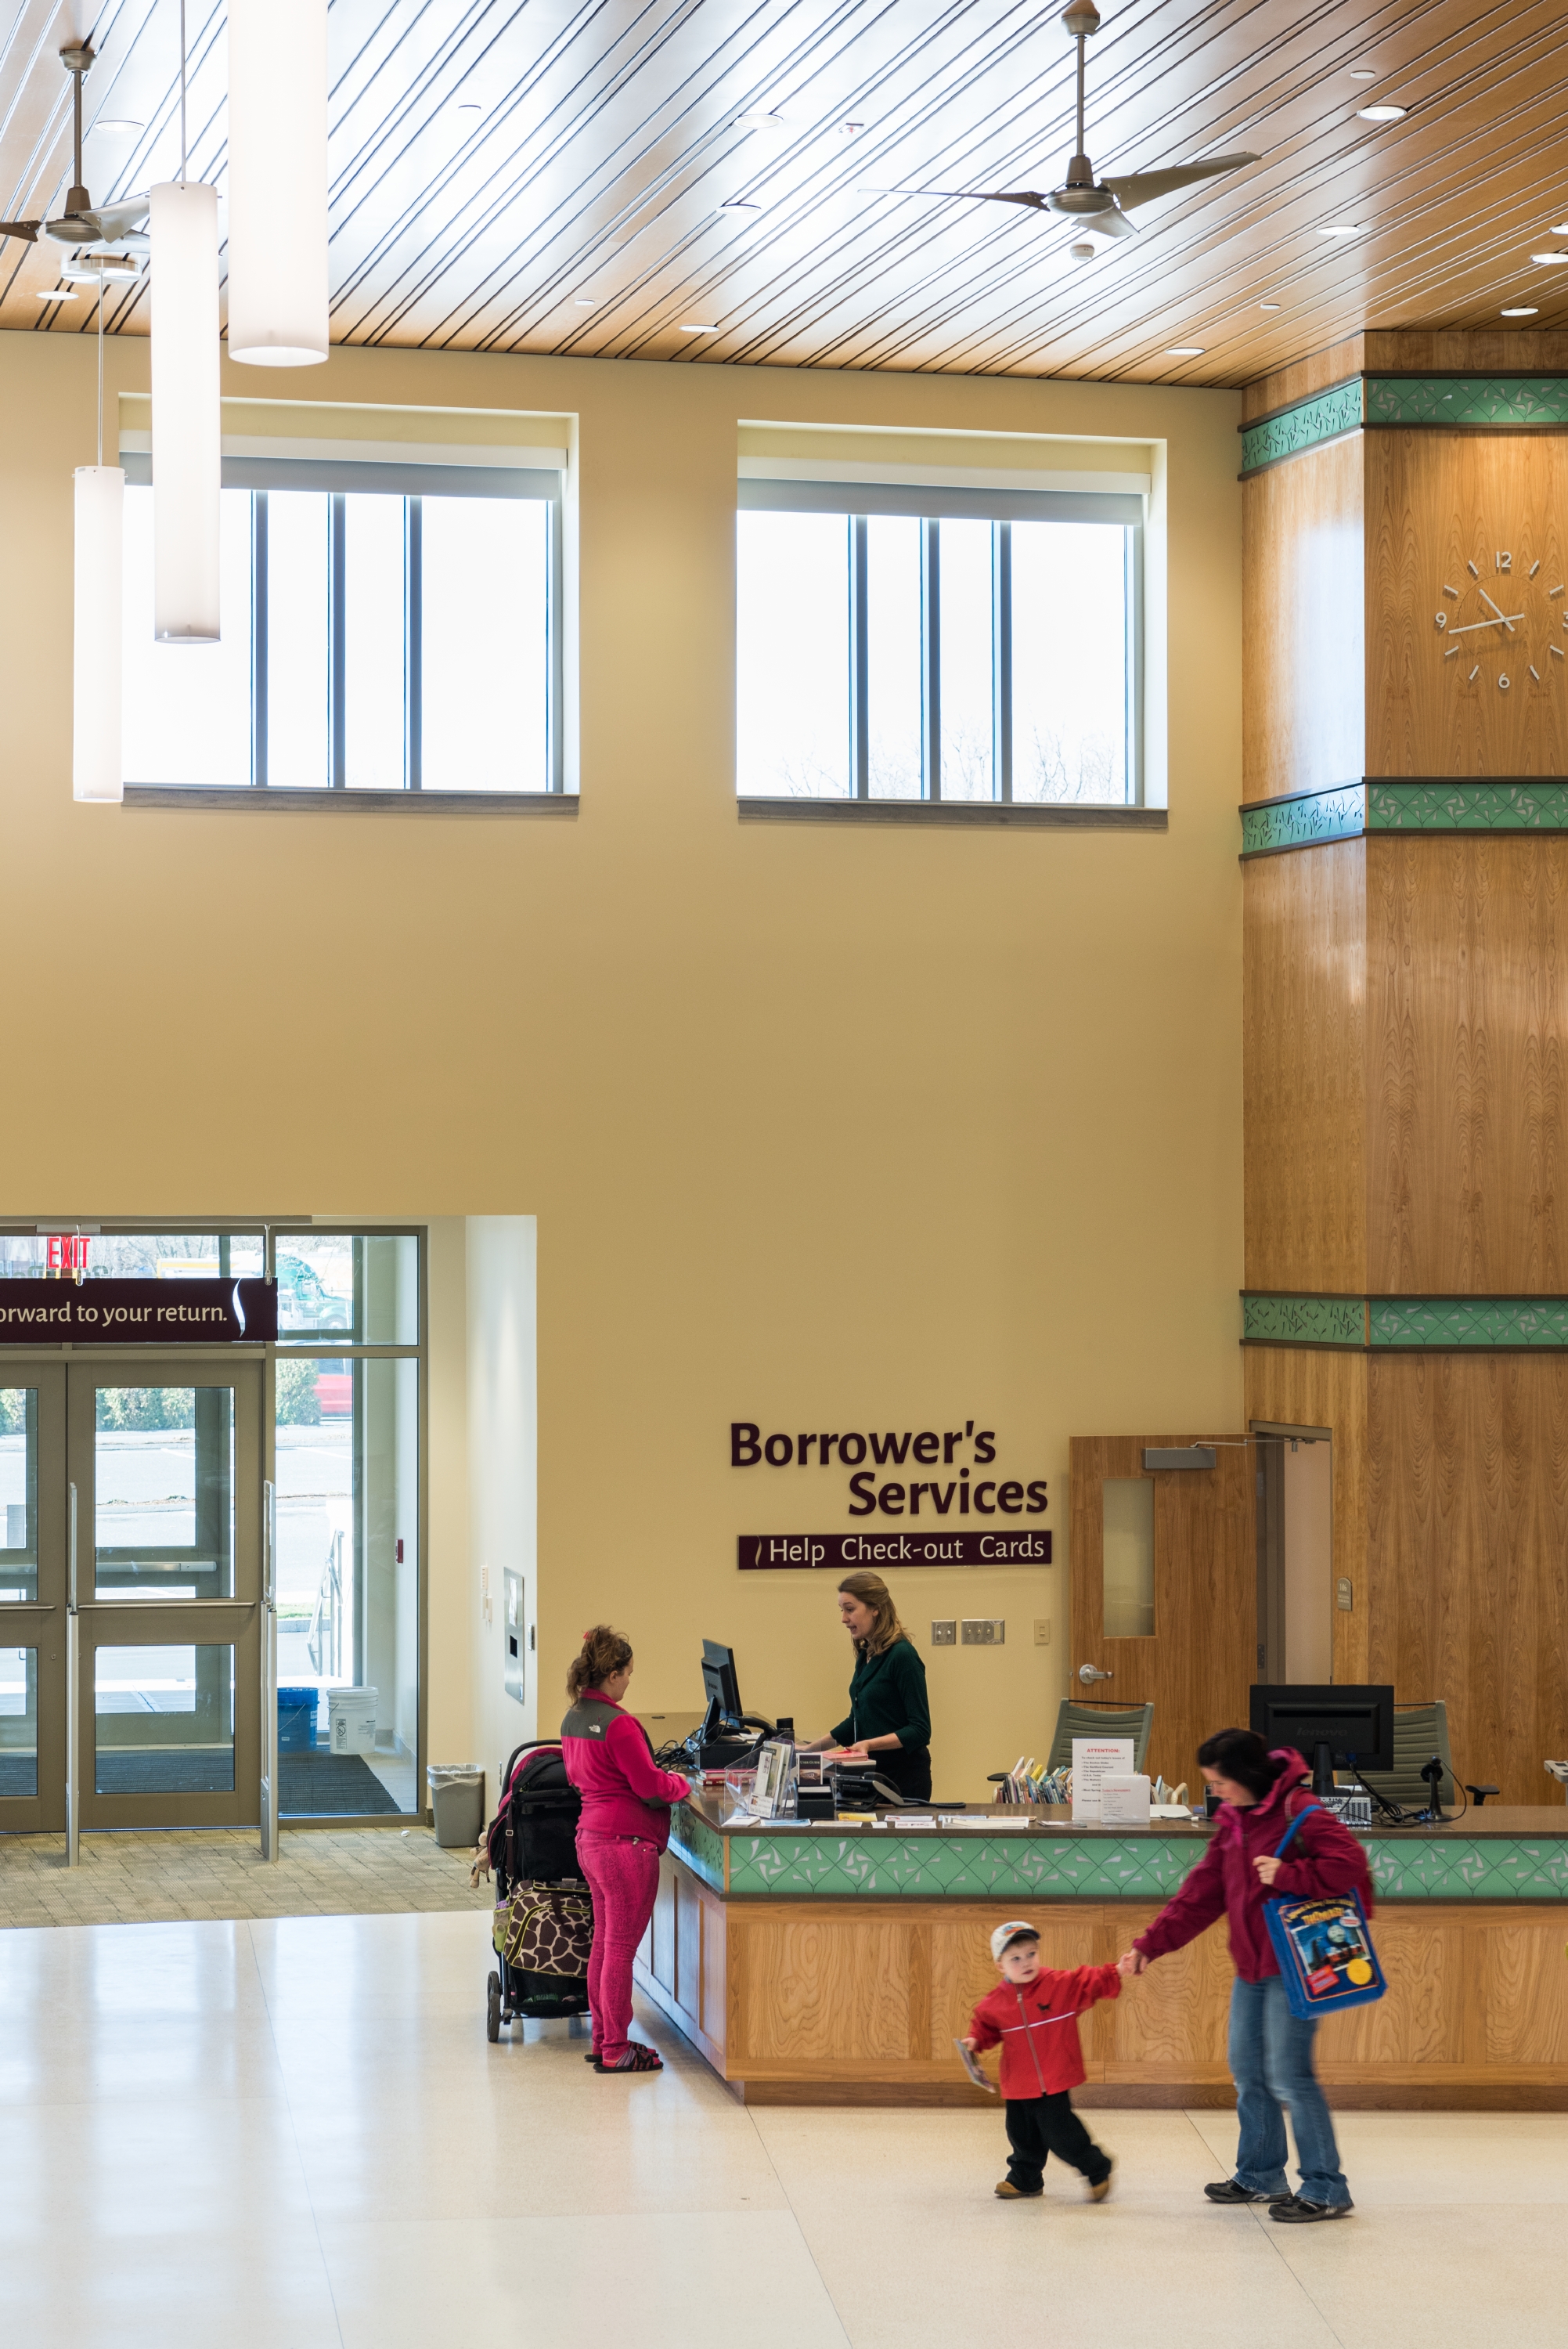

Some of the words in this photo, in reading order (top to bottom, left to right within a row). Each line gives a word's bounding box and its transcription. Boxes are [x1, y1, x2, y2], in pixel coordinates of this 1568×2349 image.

[1496, 551, 1512, 568] 12
[1435, 612, 1447, 628] 9
[1498, 673, 1510, 689] 6
[48, 1236, 90, 1269] EXIT
[77, 1305, 98, 1322] to
[102, 1307, 152, 1327] your
[157, 1304, 228, 1322] return.
[730, 1420, 997, 1467] Borrower's
[848, 1467, 1048, 1515] Services
[770, 1537, 825, 1566] Help
[841, 1535, 964, 1561] Check-out
[979, 1534, 1044, 1558] Cards
[1296, 1727, 1348, 1737] lenovo
